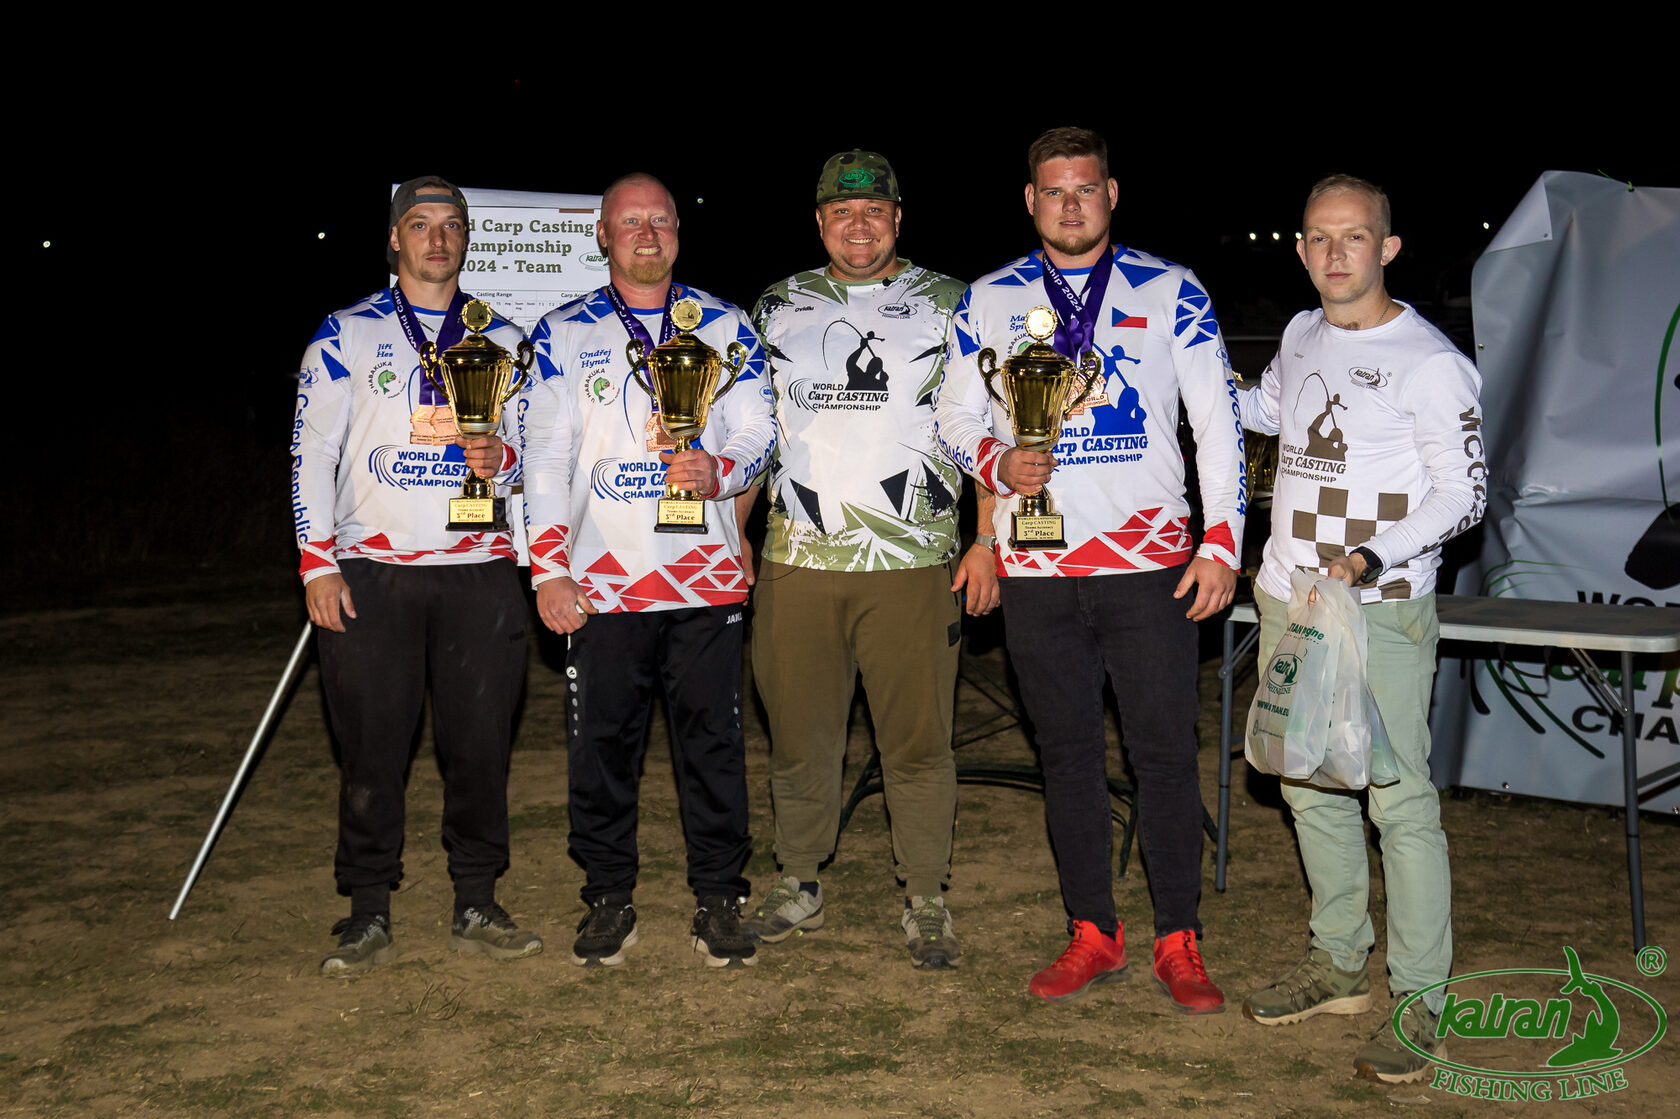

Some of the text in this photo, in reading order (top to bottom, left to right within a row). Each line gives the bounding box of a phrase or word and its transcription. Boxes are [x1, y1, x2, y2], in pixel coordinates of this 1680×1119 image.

[482, 219, 523, 236] Carp
[529, 219, 594, 237] Casting
[467, 240, 572, 256] ampionship
[514, 260, 562, 273] Team
[1061, 286, 1082, 312] 2024
[581, 357, 611, 368] Hynek
[813, 383, 844, 391] WORLD
[808, 391, 889, 403] Carp CASTING
[813, 403, 881, 411] CHAMPIONSHIP
[1060, 427, 1090, 438] ORLD
[1051, 436, 1149, 456] arp CASTING
[397, 451, 440, 461] WORLD
[1058, 453, 1143, 466] HAMPIONSHIP
[392, 462, 469, 478] Carp CAST
[618, 462, 658, 472] WORLD
[1295, 456, 1346, 475] CASTING
[615, 473, 646, 490] Carp
[1281, 467, 1337, 483] CHAMPIONSHIP
[400, 478, 462, 487] CHAMPION
[623, 490, 664, 499] CHAMPI
